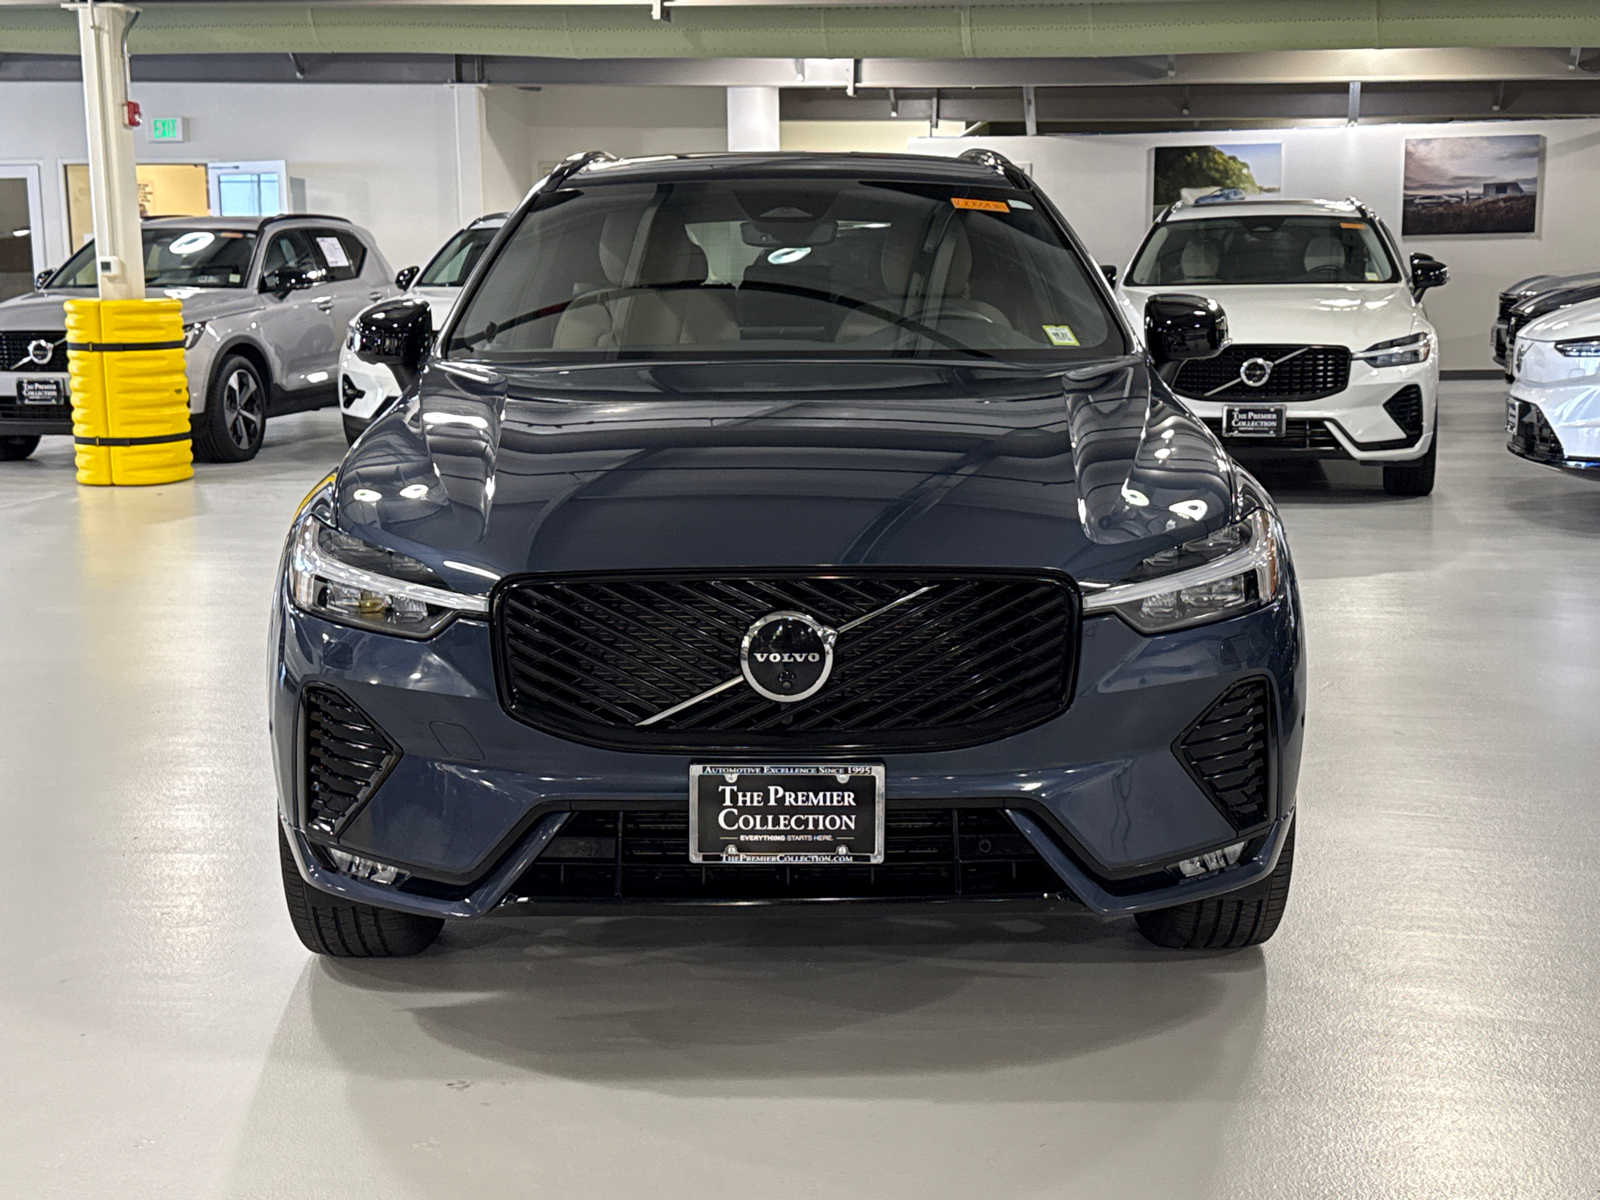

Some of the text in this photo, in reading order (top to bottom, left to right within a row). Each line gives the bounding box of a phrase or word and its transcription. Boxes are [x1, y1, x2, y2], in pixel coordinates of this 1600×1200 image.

[153, 118, 176, 139] EXIT
[1232, 411, 1277, 419] THE PREMIER
[753, 652, 820, 663] VOLVO
[704, 765, 871, 775] AUTOMOTIVE EXCELLENCE SINCE 1995
[718, 785, 857, 806] THE PREMIER
[718, 808, 857, 830] COLLECTION
